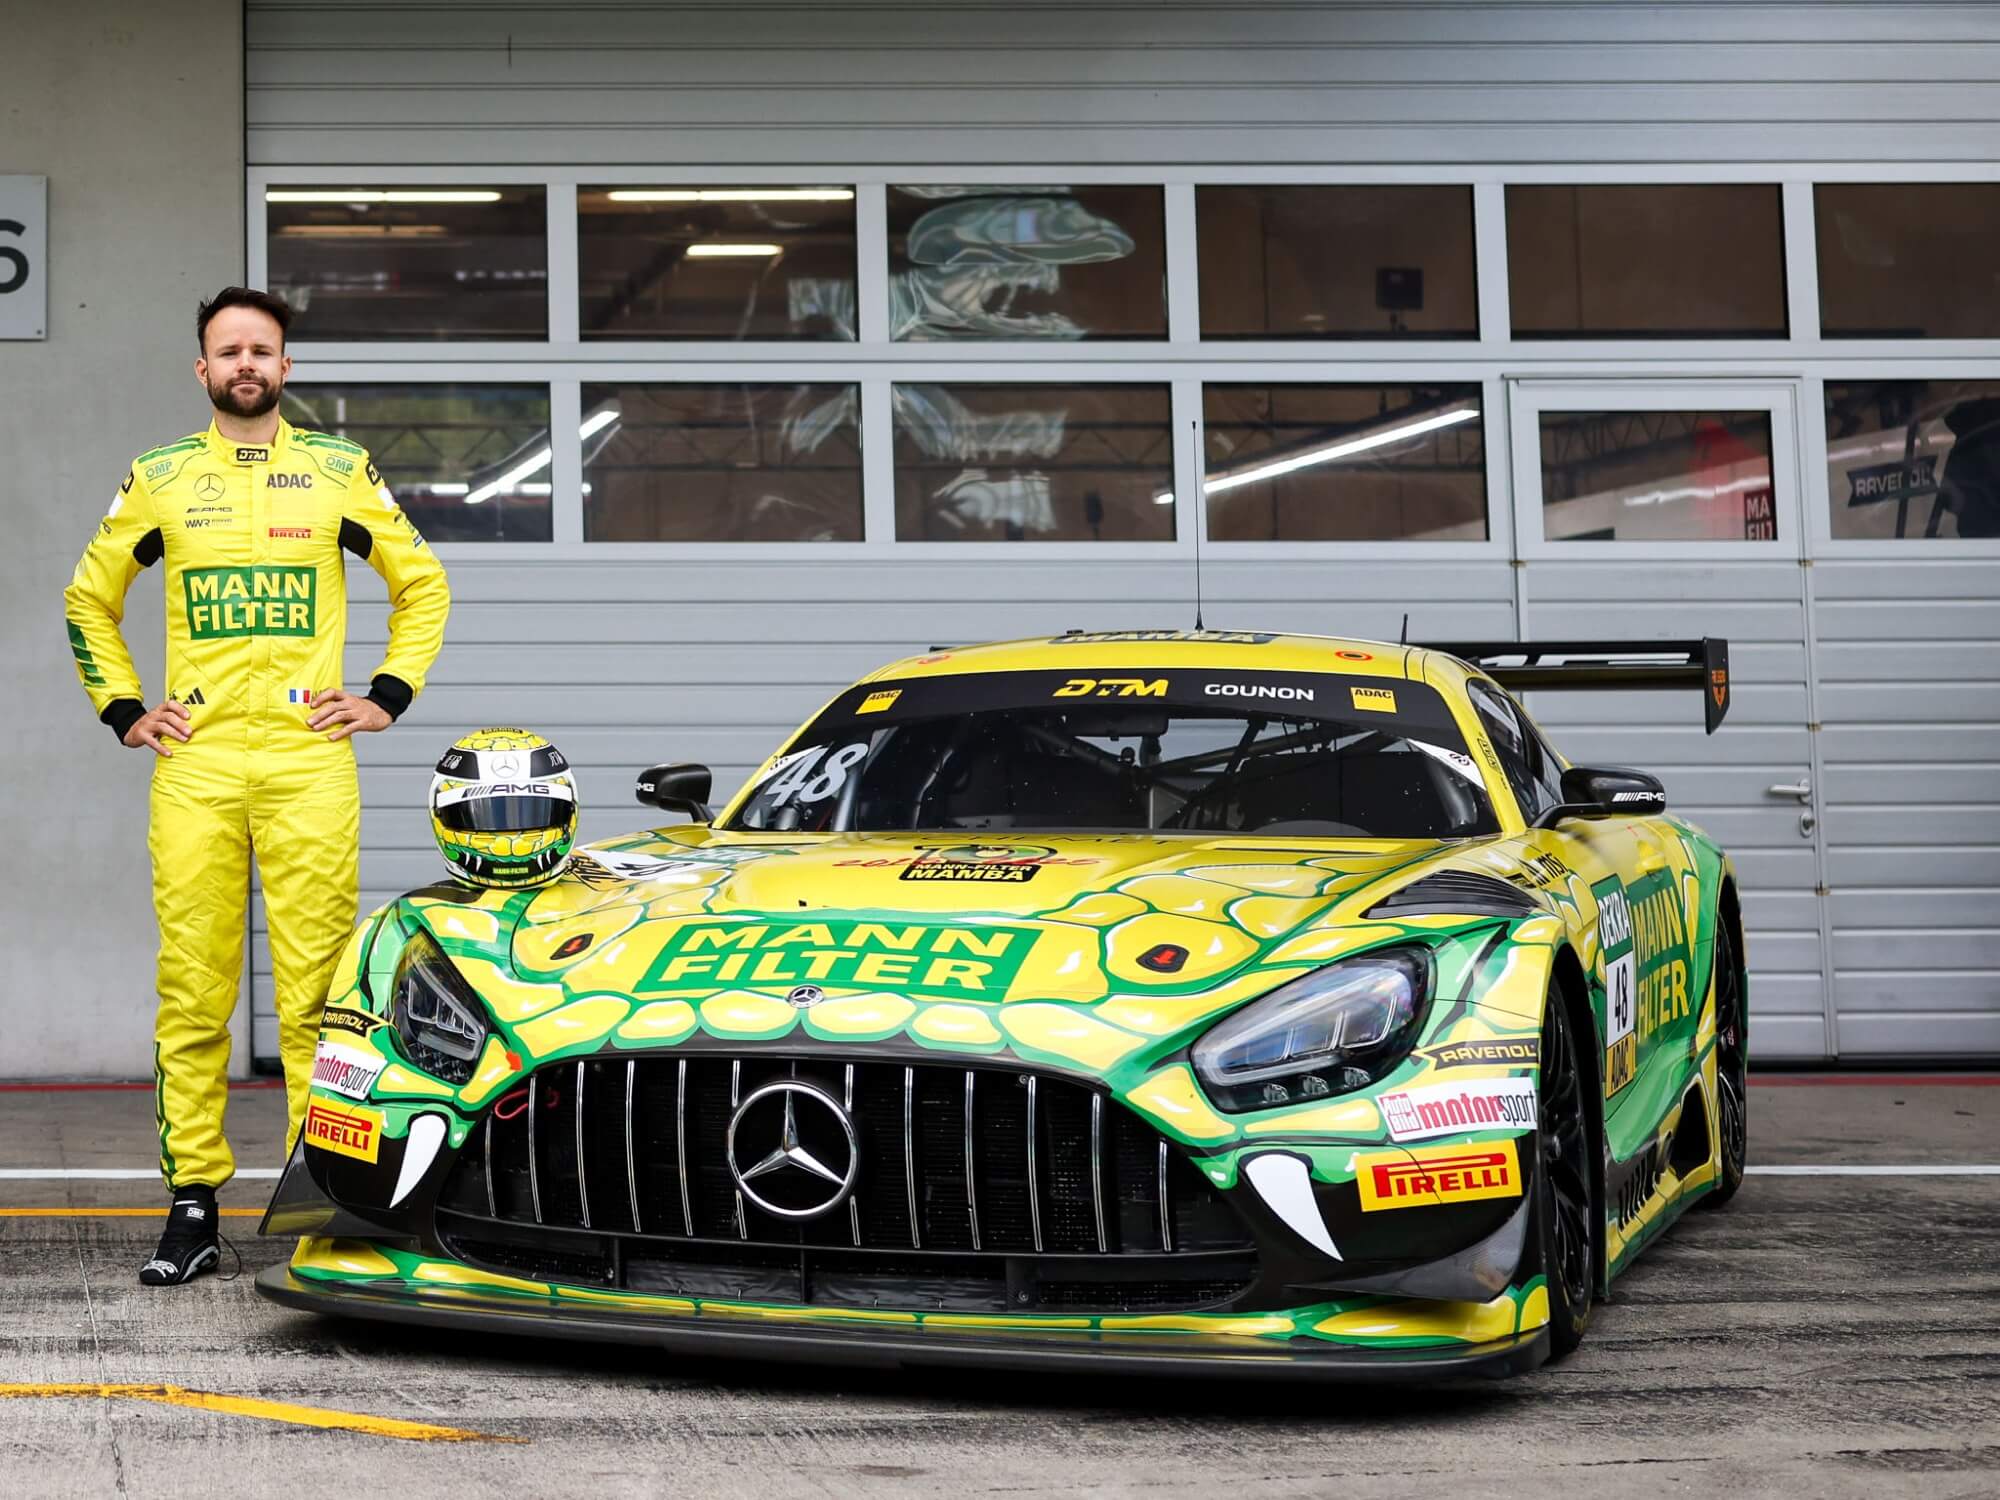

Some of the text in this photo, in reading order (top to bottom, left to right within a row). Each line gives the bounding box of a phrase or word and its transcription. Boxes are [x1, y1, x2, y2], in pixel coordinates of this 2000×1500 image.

[145, 461, 172, 478] OMP
[238, 449, 266, 460] DTM
[326, 456, 354, 473] OMP
[266, 473, 313, 489] ADAC
[268, 527, 312, 539] PIRELLI
[189, 572, 310, 602] MANN
[192, 602, 310, 632] FILTER
[1052, 679, 1169, 697] DTM
[1204, 684, 1314, 700] GOUNON
[1355, 688, 1392, 699] ADAC
[489, 784, 550, 795] AMG
[765, 743, 869, 807] 48
[906, 869, 1025, 880] MAMBA
[1600, 888, 1631, 950] DEKRA
[1633, 887, 1684, 968] MANN
[679, 923, 1014, 957] MANN
[657, 951, 993, 990] FILTER
[1615, 962, 1628, 1033] 48
[1637, 959, 1690, 1045] FILTER
[322, 1012, 365, 1030] RAVENOL
[1439, 1044, 1534, 1062] RAVENOL
[1610, 1042, 1629, 1092] ADAC
[1417, 1090, 1536, 1129] motorsport
[307, 1105, 373, 1151] PIRELLI
[1371, 1152, 1510, 1199] PIRELLI
